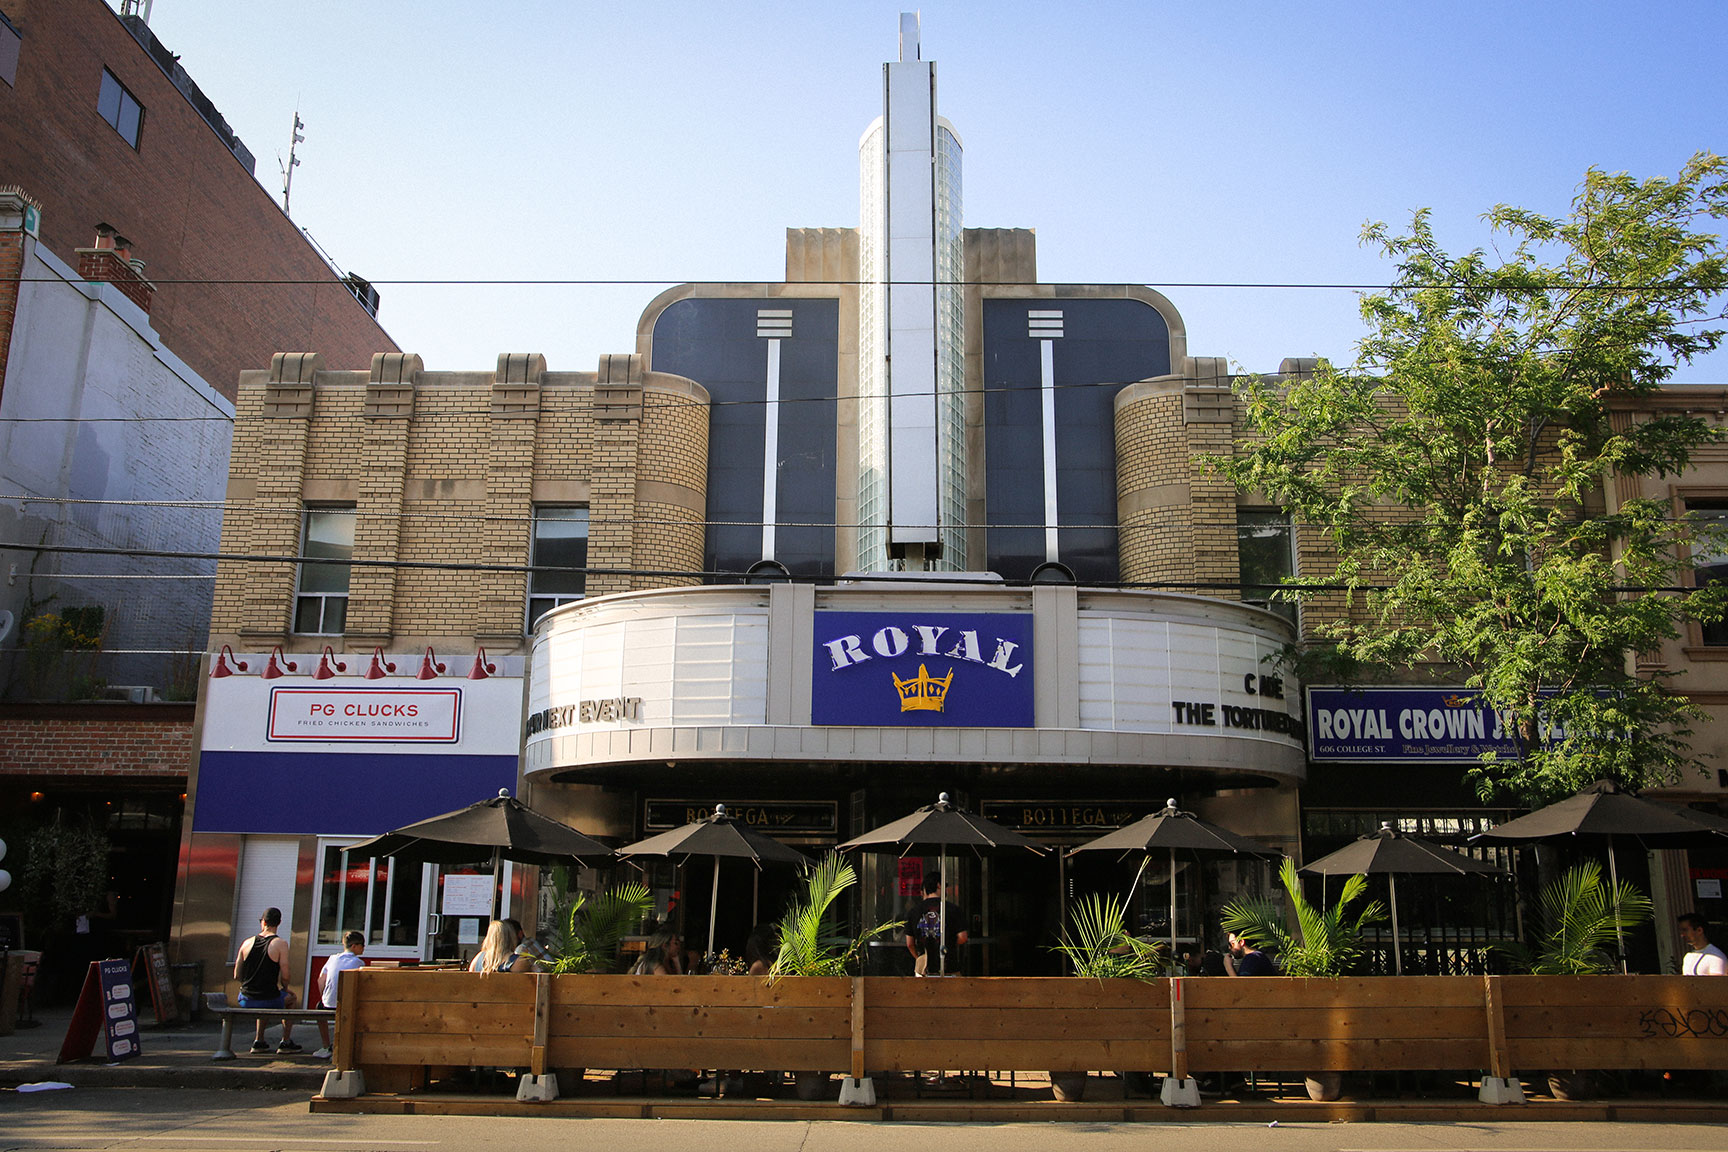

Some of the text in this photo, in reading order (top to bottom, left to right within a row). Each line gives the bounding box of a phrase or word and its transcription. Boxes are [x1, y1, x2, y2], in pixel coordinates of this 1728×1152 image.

[822, 624, 1024, 678] ROYAL
[309, 704, 419, 717] PG CLUCKS
[579, 696, 642, 723] EVENT
[1172, 701, 1216, 725] THE
[1317, 709, 1394, 740] ROYAL
[1399, 709, 1486, 740] CROWN
[1319, 745, 1335, 753] 606
[1336, 745, 1373, 753] COLLEGE
[1402, 744, 1424, 754] Fine
[1023, 808, 1107, 825] BOTTEGA
